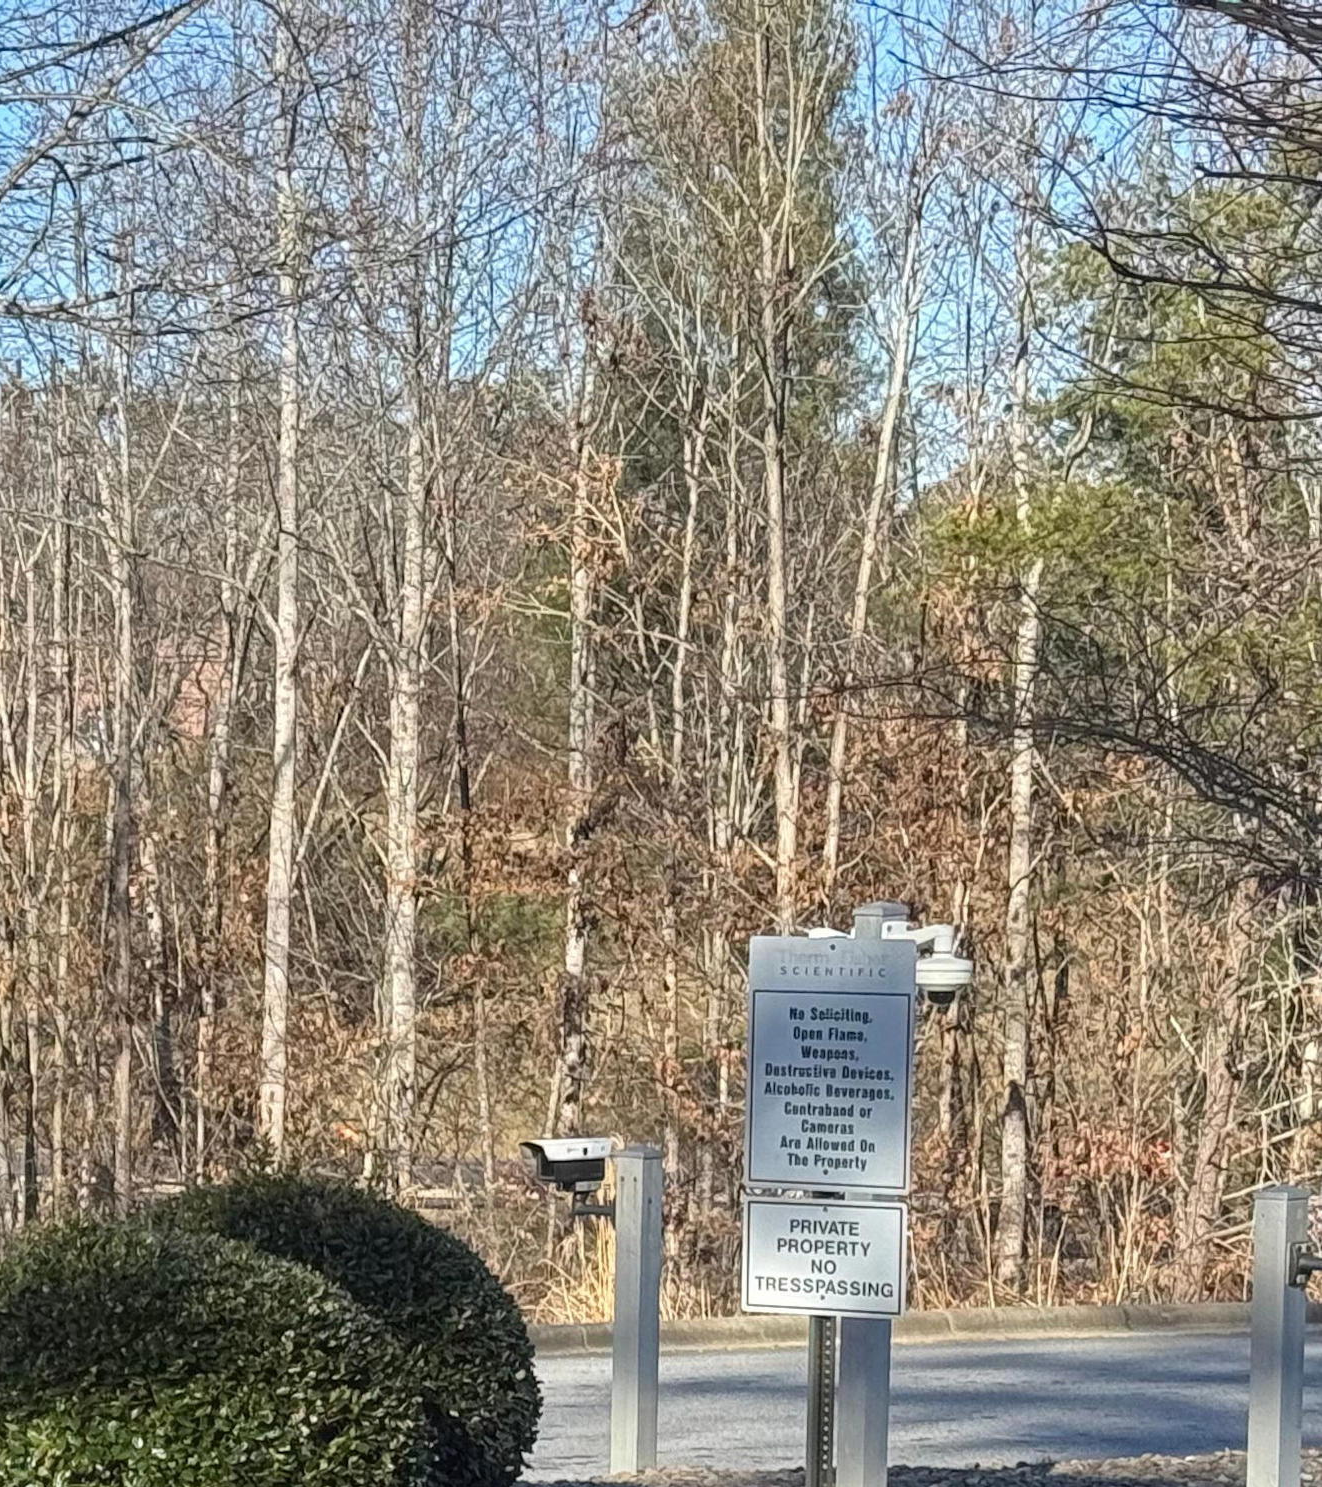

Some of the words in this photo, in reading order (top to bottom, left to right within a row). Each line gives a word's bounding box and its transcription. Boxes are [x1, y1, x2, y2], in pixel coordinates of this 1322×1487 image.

[780, 966, 886, 978] SCIENTIFIC
[789, 1006, 805, 1021] No
[810, 1006, 873, 1025] Soliciting,
[793, 1026, 823, 1042] Open
[828, 1027, 868, 1043] Flame,
[801, 1045, 859, 1062] Weapons,
[765, 1062, 836, 1079] Destructive
[842, 1065, 895, 1082] Devices,
[764, 1081, 820, 1097] Alcoholic
[784, 1101, 854, 1118] Contraband
[859, 1107, 873, 1119] or
[801, 1119, 854, 1135] Cameras
[780, 1136, 801, 1150] Are
[807, 1137, 855, 1152] Allowed
[860, 1139, 875, 1153] On
[787, 1153, 808, 1167] The
[814, 1154, 867, 1171] Property
[790, 1219, 860, 1236] PRIVATE
[777, 1238, 871, 1257] PROPERTY
[811, 1260, 837, 1275] NO
[755, 1276, 894, 1298] TRESSPASSING
